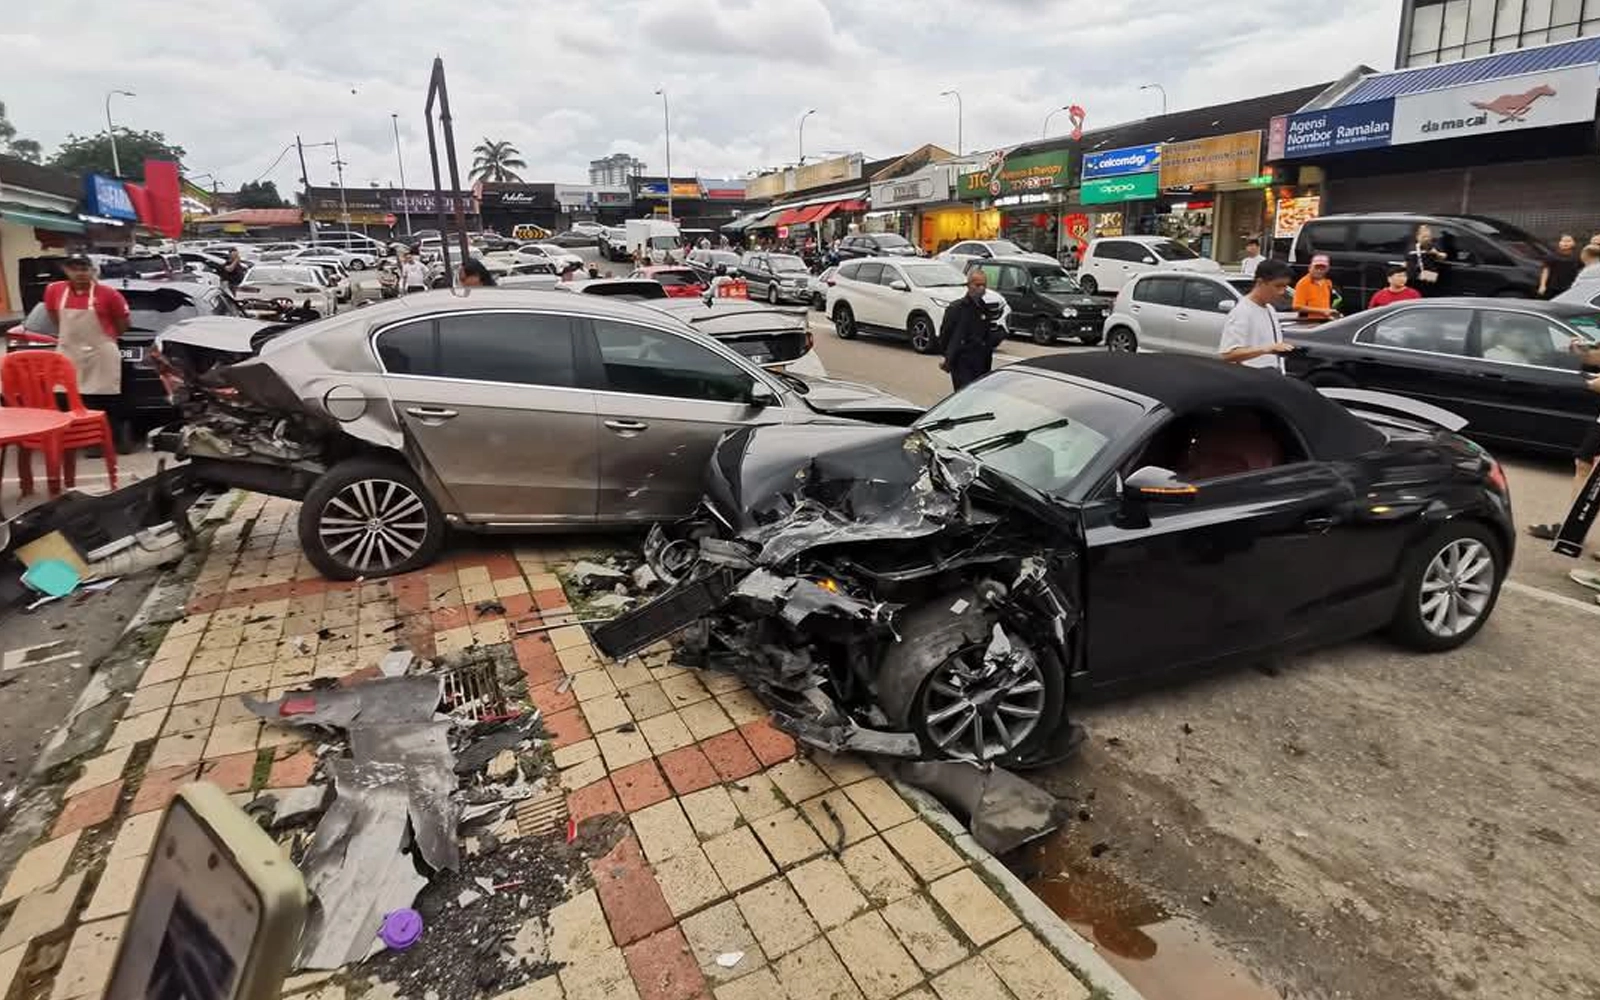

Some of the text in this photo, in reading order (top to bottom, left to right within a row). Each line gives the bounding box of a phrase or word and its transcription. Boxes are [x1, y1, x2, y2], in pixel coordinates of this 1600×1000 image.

[1289, 118, 1327, 134] Agensi
[1336, 121, 1390, 138] Ramalan
[1287, 129, 1332, 146] Nombor
